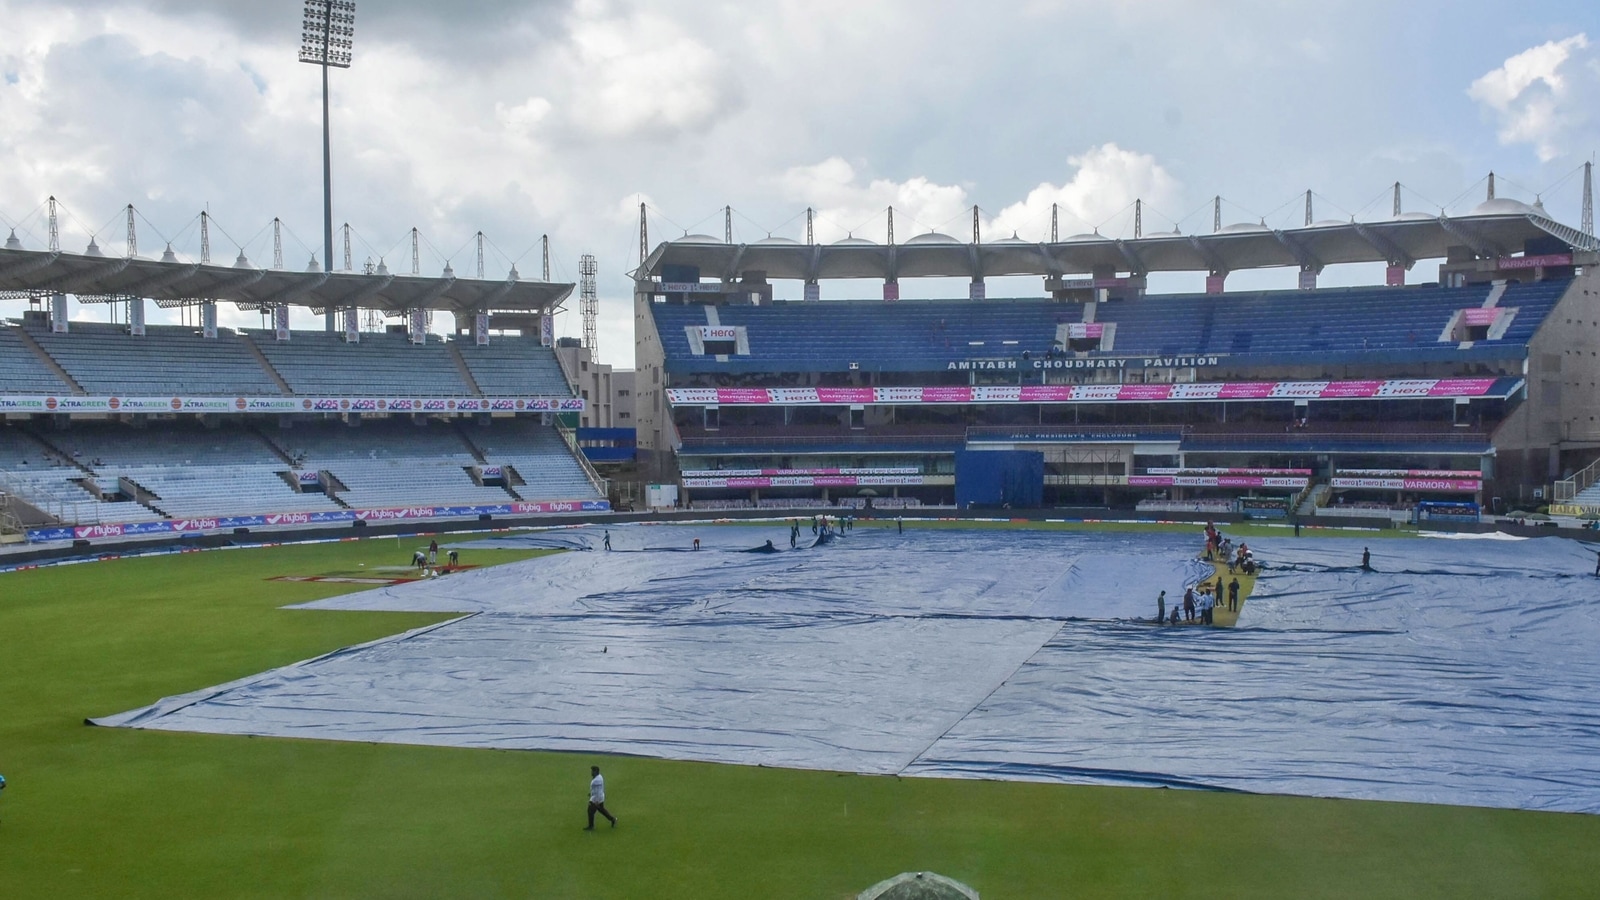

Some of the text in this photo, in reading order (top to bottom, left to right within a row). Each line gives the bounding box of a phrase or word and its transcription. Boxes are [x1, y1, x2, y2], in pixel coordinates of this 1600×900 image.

[947, 357, 1218, 370] AMITABH CHOUDHARY PAVILION
[0, 399, 295, 408] TRAGREEN XTRAGREEN XTRAGREEN XTRAGREEN XTRAGREEN
[1404, 481, 1452, 489] VARMORA
[94, 525, 120, 536] flybig
[190, 519, 216, 530] flybig
[282, 513, 307, 523] flybig
[371, 510, 394, 519] flybig
[410, 508, 432, 517] flybig
[519, 504, 540, 512] flybig
[550, 503, 572, 511] flybig
